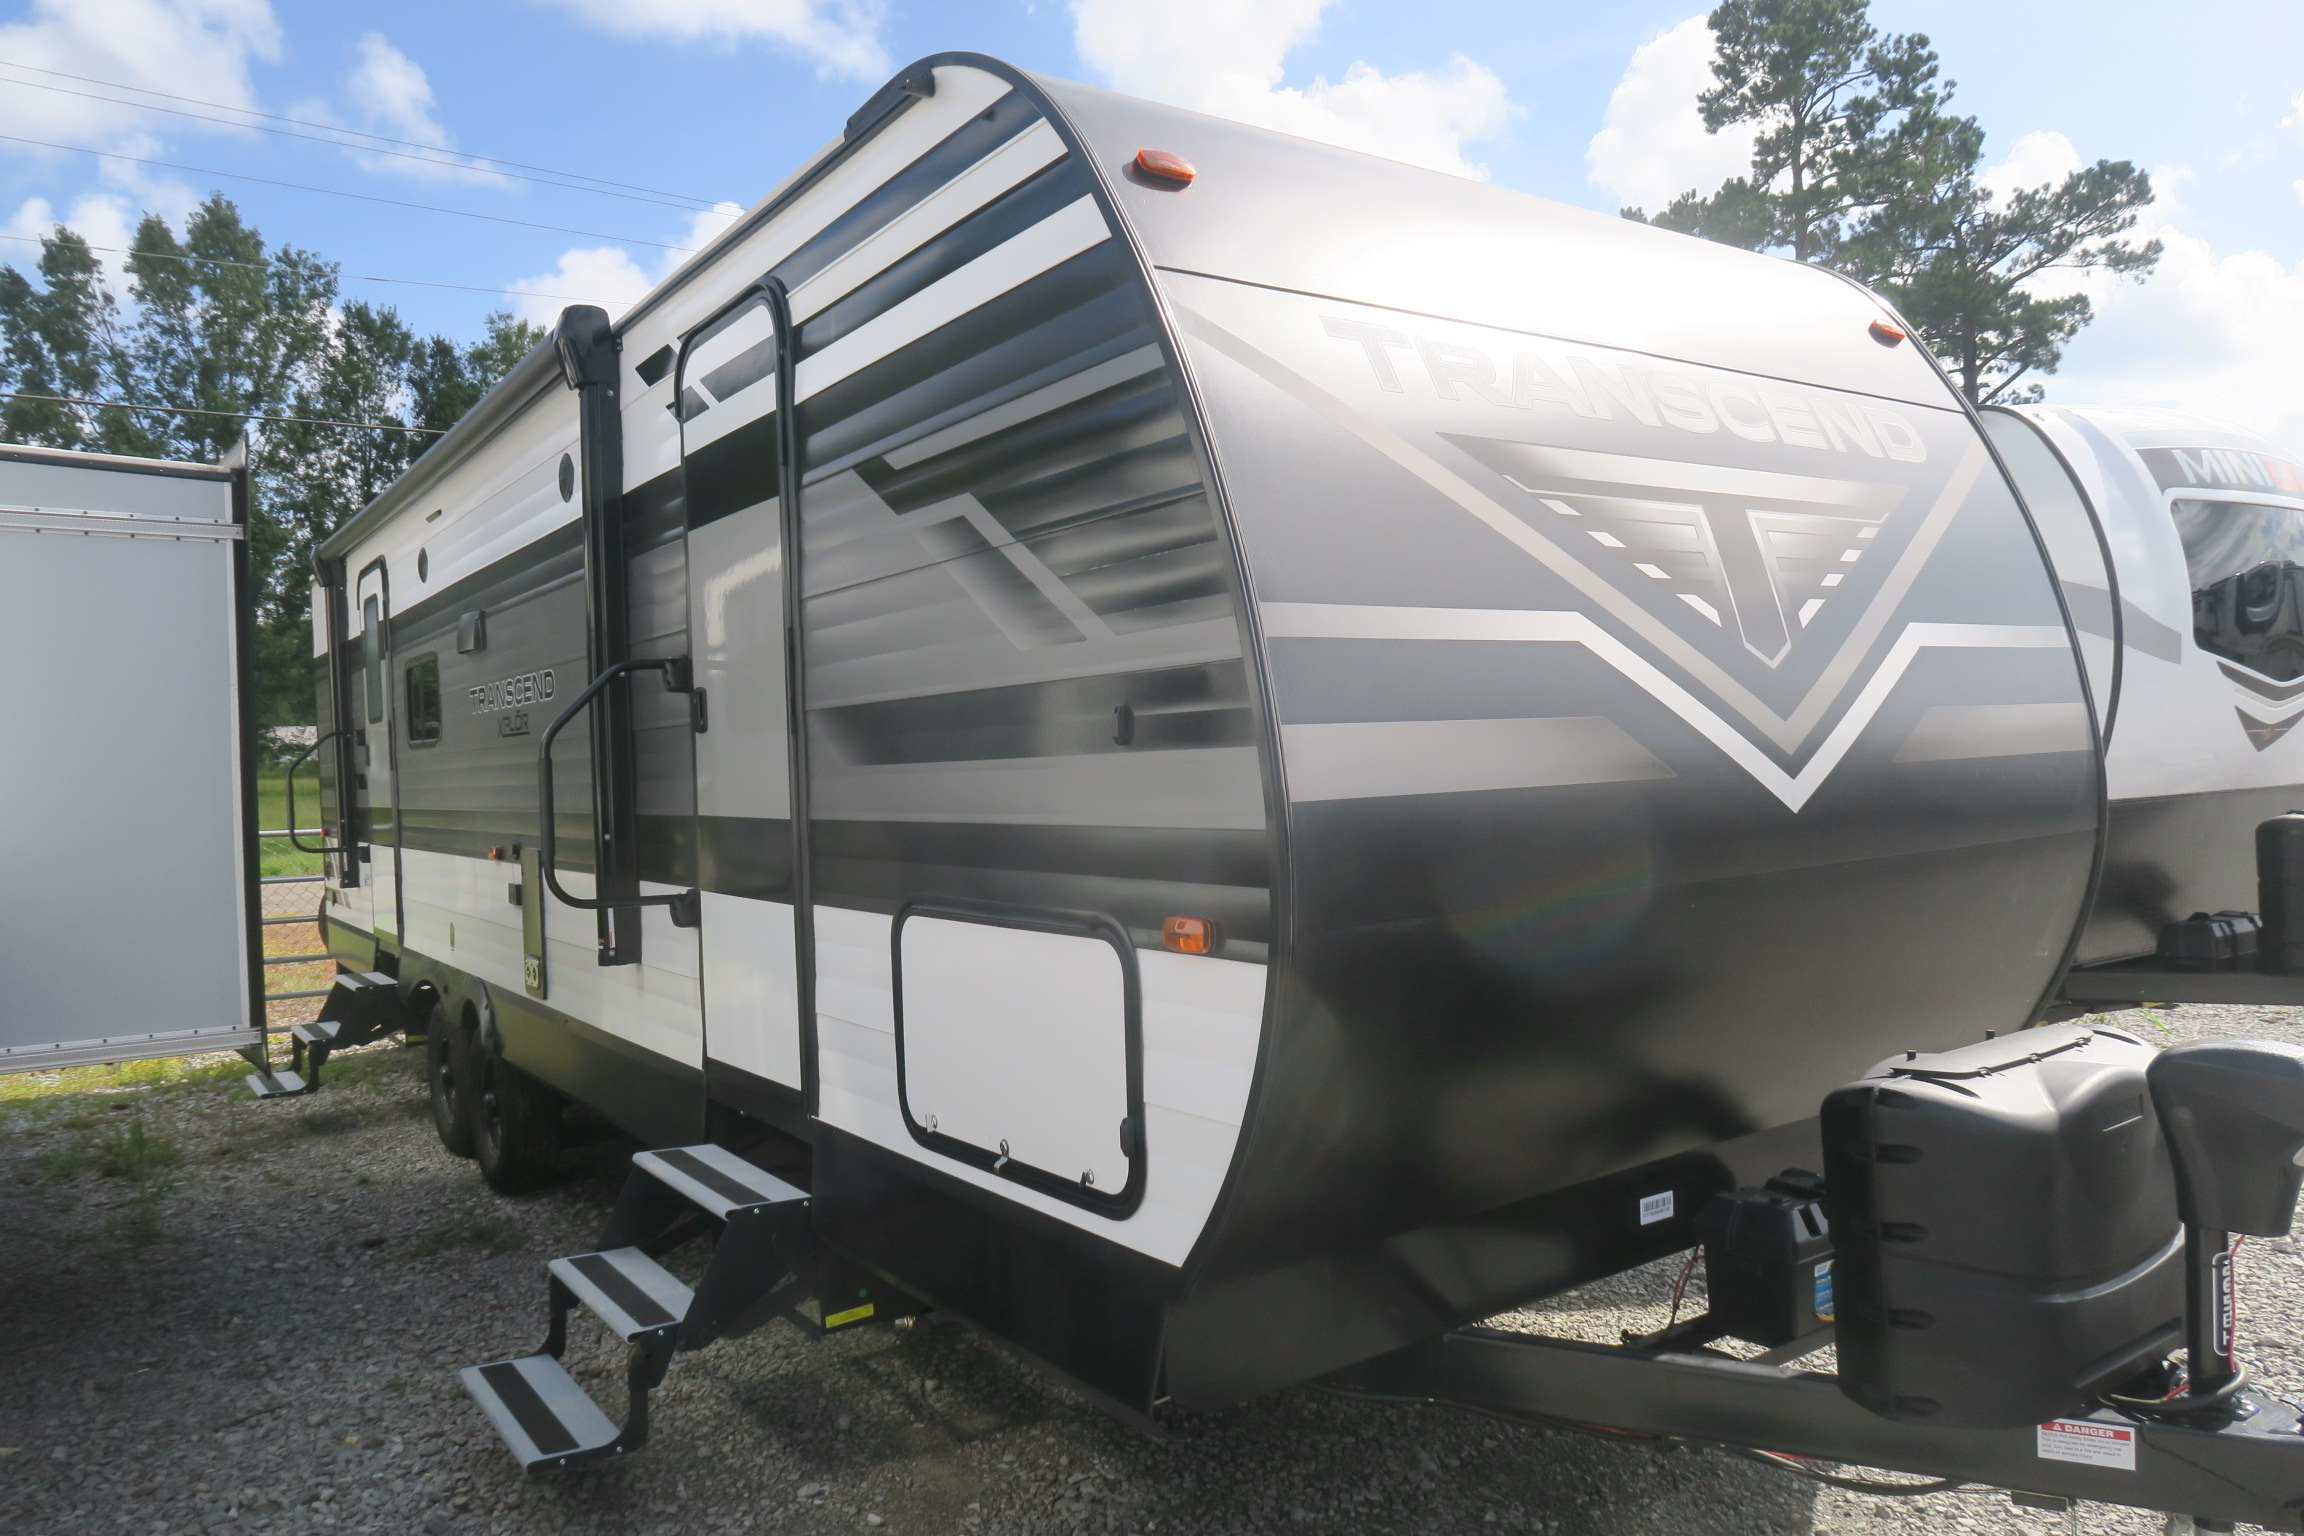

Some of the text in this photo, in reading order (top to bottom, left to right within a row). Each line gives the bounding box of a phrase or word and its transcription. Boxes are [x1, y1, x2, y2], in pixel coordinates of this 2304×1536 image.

[1318, 315, 1927, 464] TRANSCEND
[469, 669, 556, 715] TRANSCEND
[2064, 1424, 2115, 1438] DANGER
